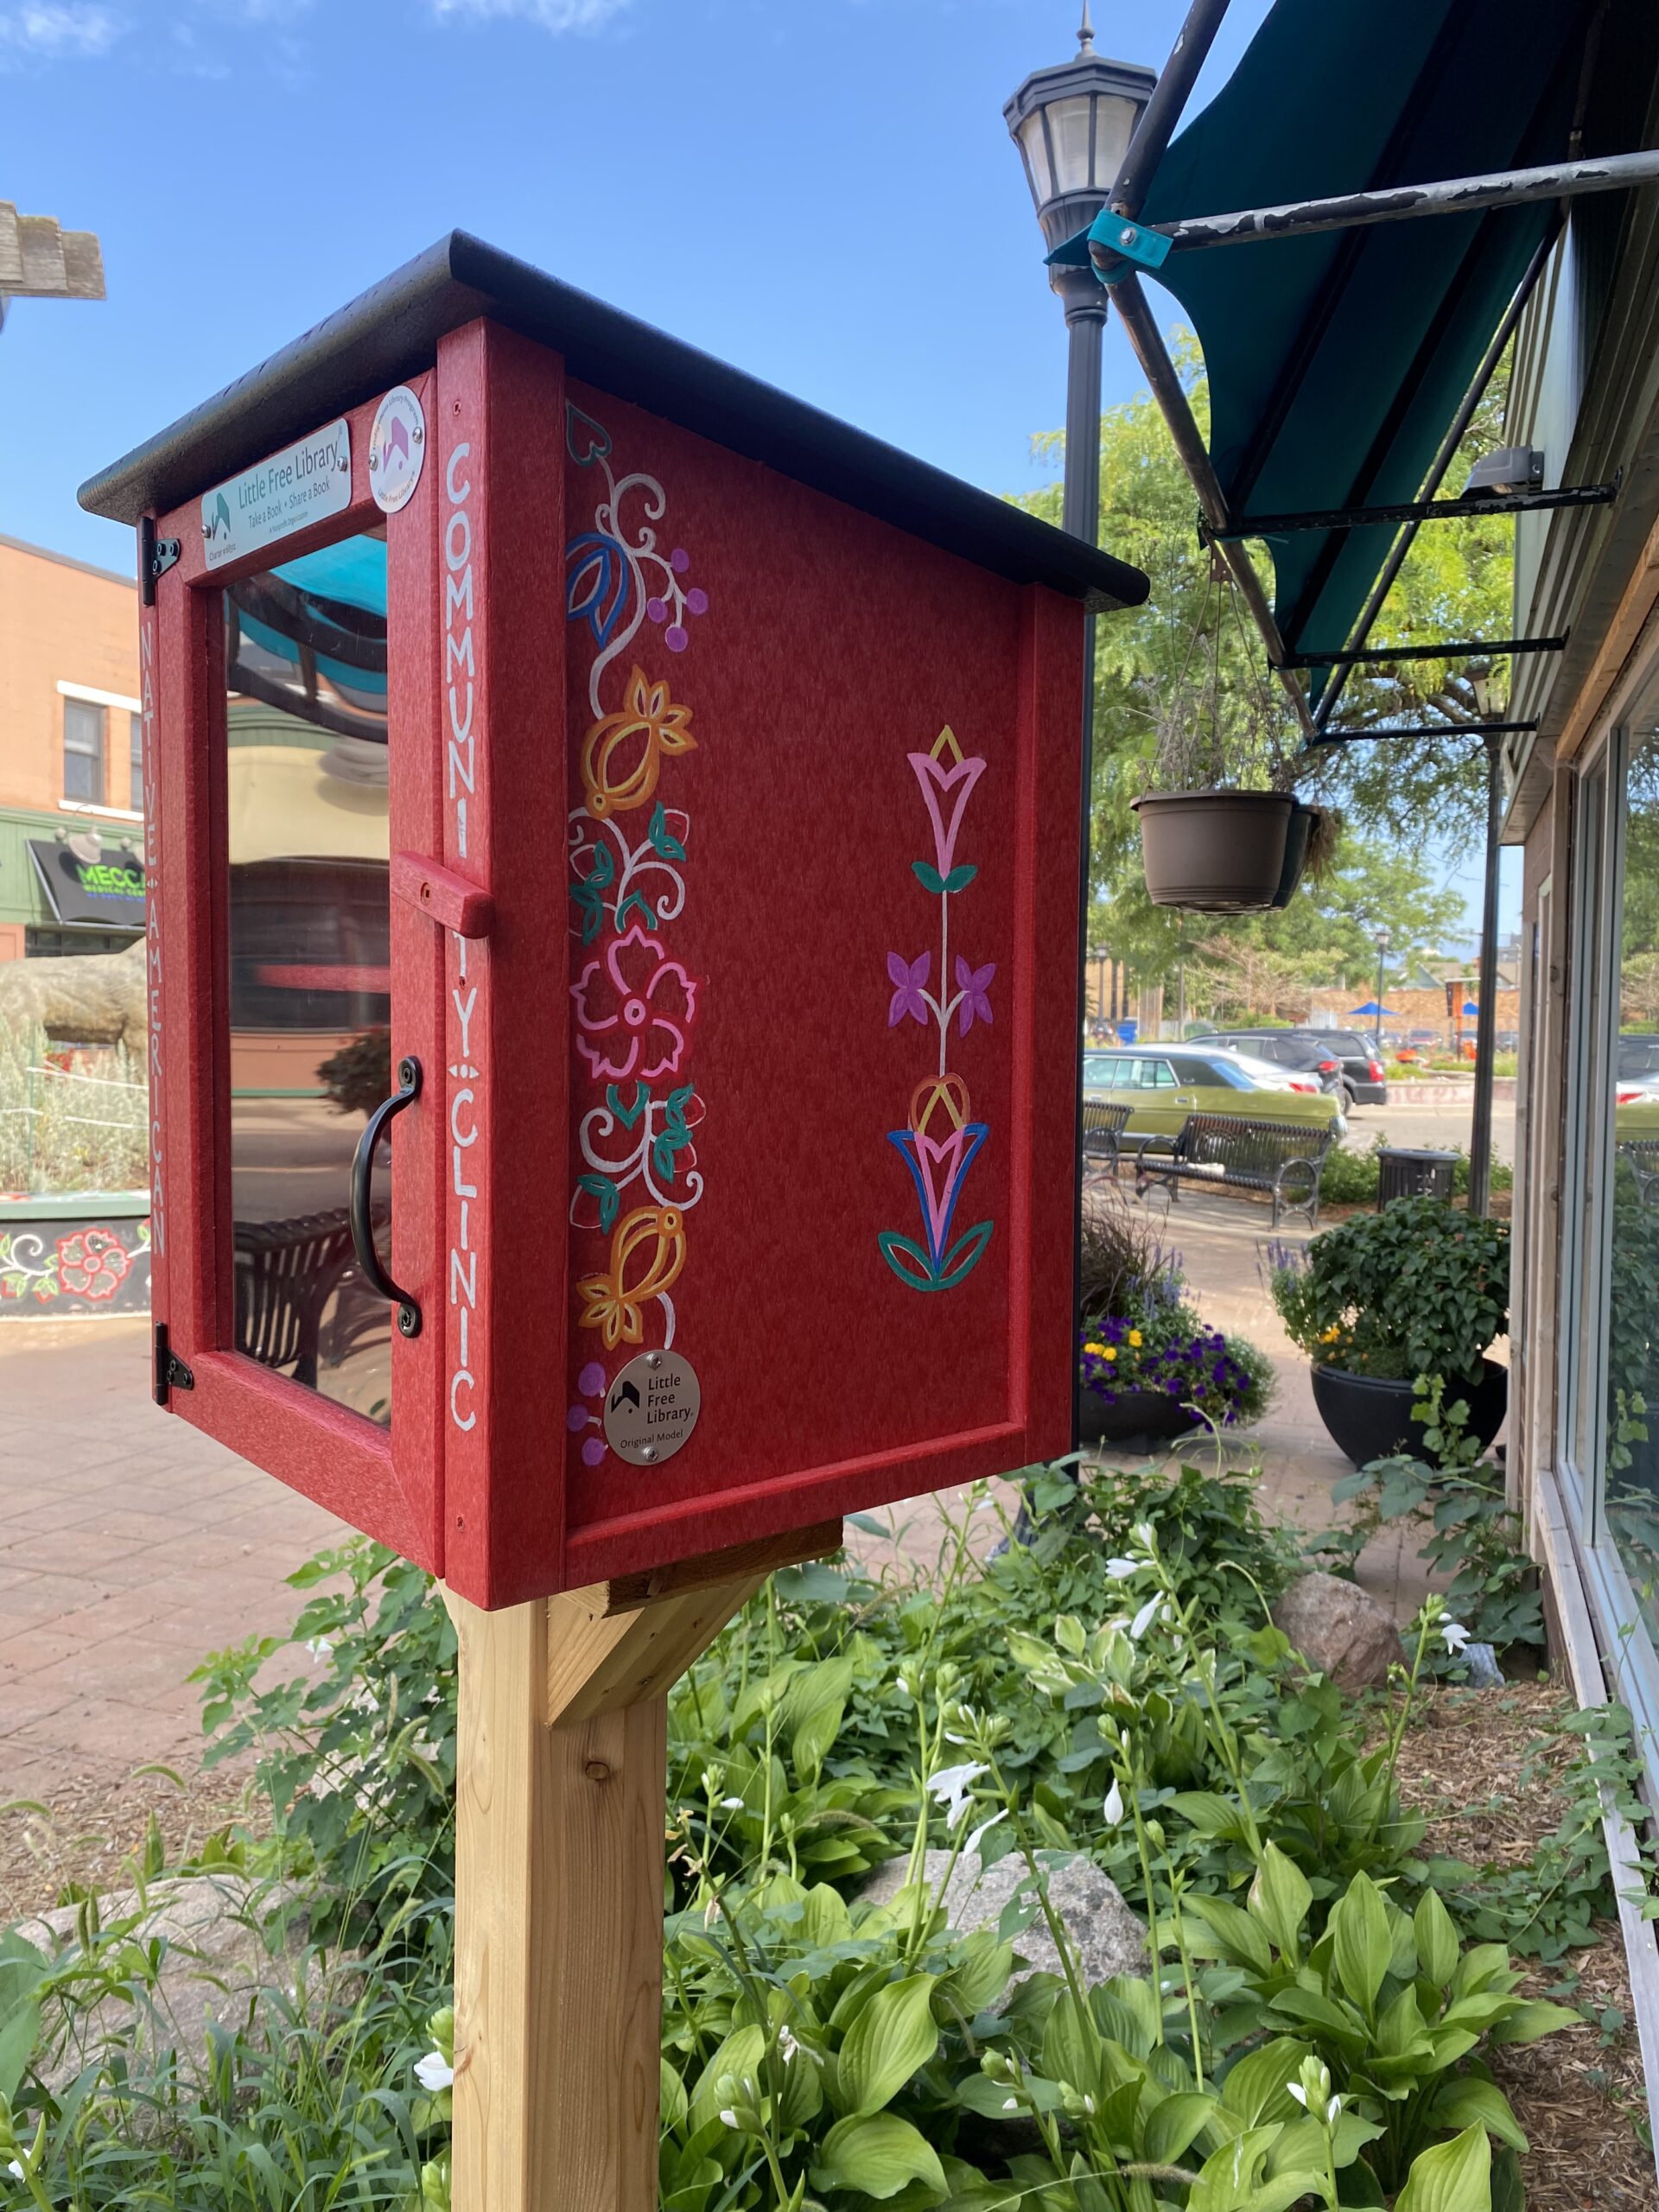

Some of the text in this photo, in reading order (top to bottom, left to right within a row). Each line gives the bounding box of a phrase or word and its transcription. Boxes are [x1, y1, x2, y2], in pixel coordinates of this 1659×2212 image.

[388, 395, 404, 406] Library
[404, 396, 419, 425] Program
[238, 441, 338, 510] Little Free Library
[248, 511, 262, 530] Take
[267, 499, 283, 520] Book
[289, 491, 308, 509] Share
[308, 488, 312, 500] a
[313, 475, 330, 498] Book
[388, 494, 398, 503] Free
[141, 621, 165, 1259] NATIVE AMERICAN
[449, 1088, 478, 1432] CLINIC
[648, 1373, 681, 1390] Little
[647, 1394, 676, 1408] Free
[646, 1408, 691, 1424] Library
[620, 1428, 683, 1449] Original Model
